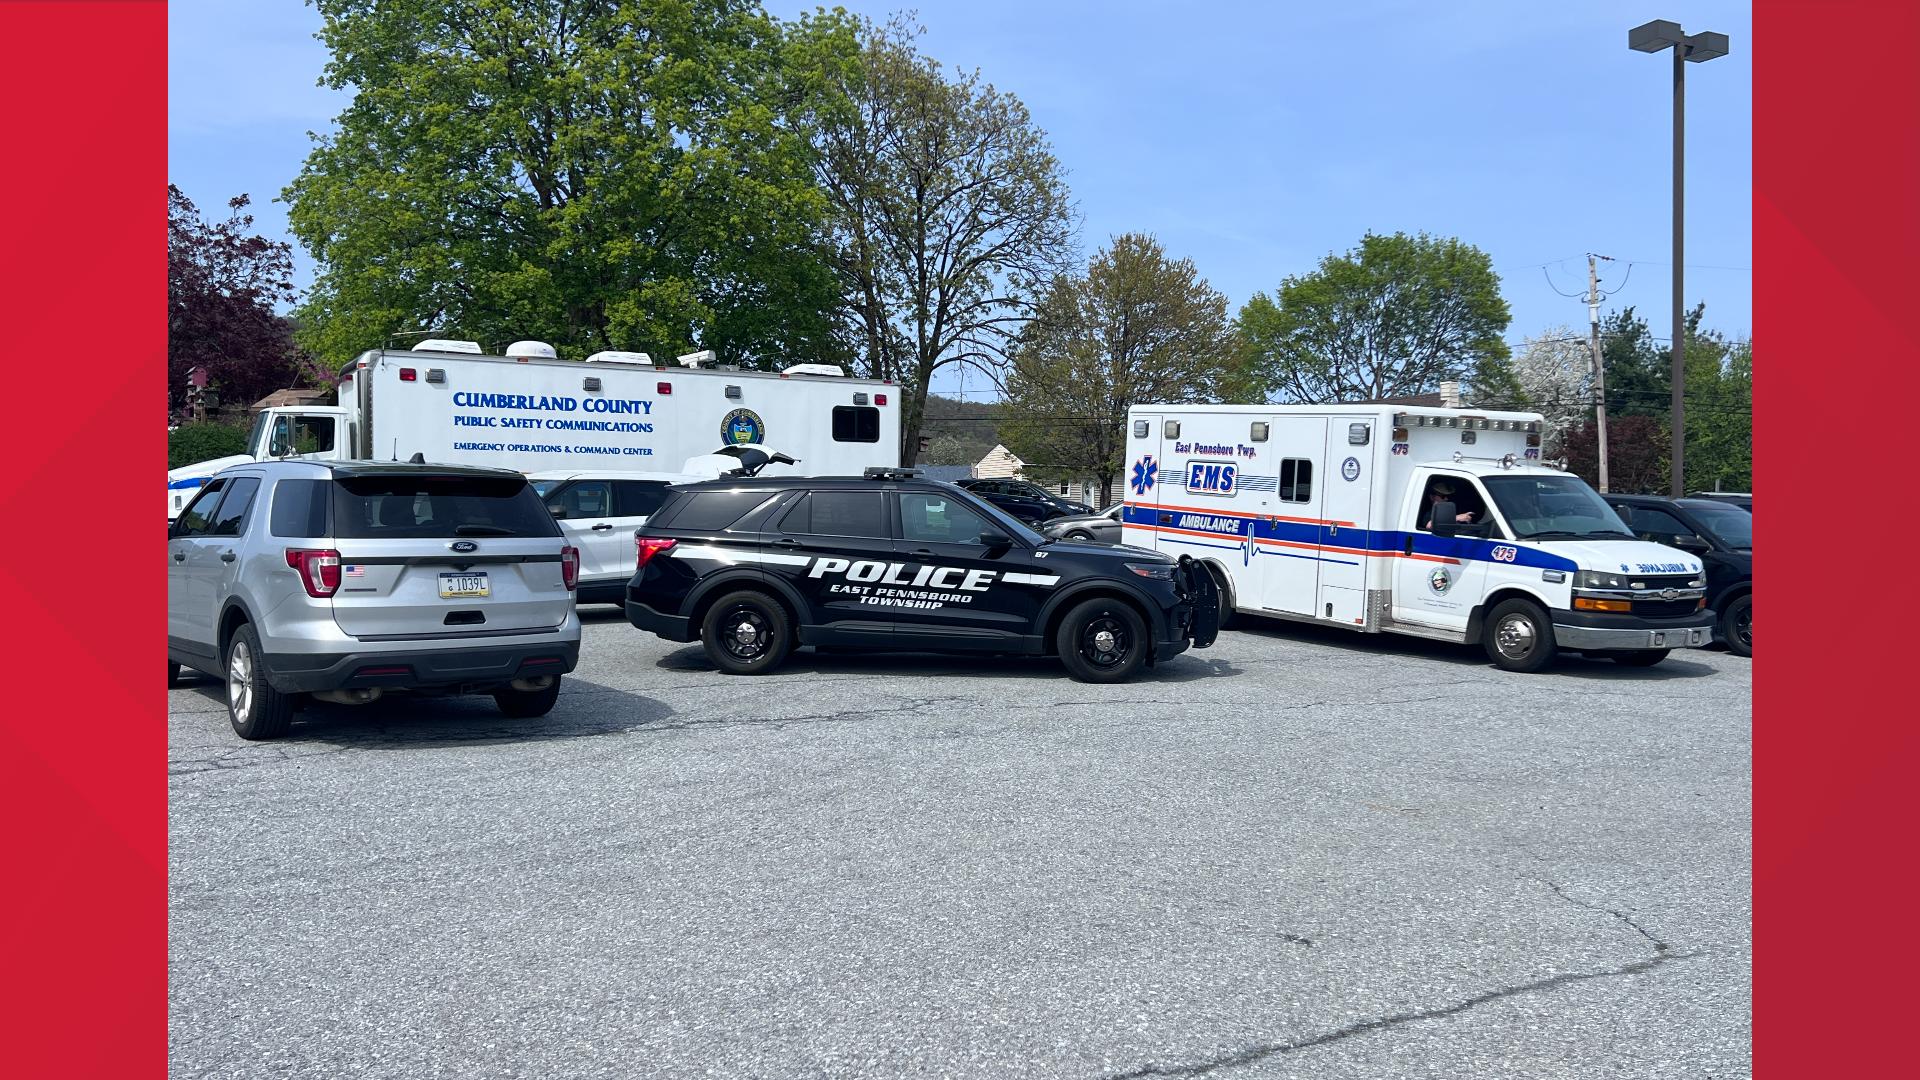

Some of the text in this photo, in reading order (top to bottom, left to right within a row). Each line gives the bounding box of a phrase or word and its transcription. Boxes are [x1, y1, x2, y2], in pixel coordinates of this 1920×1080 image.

[453, 392, 653, 414] CUMBERLAND COUNTY
[454, 416, 653, 433] PUBLIC SAFETY COMMUNICATIONS
[454, 442, 505, 451] EMERGENCY
[507, 444, 562, 453] OPERATIONS
[574, 446, 620, 455] COMMAND
[623, 448, 653, 456] CENTER
[1175, 442, 1257, 459] East Pennsboro Twp.
[1391, 443, 1409, 456] 475
[1524, 448, 1539, 460] 475
[1189, 464, 1235, 492] EMS
[1179, 514, 1240, 533] AMBULANCE
[456, 542, 473, 550] Ford
[1492, 545, 1517, 562] 475
[807, 557, 998, 592] POLICE
[457, 577, 486, 591] 1039L
[829, 585, 973, 604] EAST PENNSBORO
[859, 596, 943, 610] TOWNSHIP
